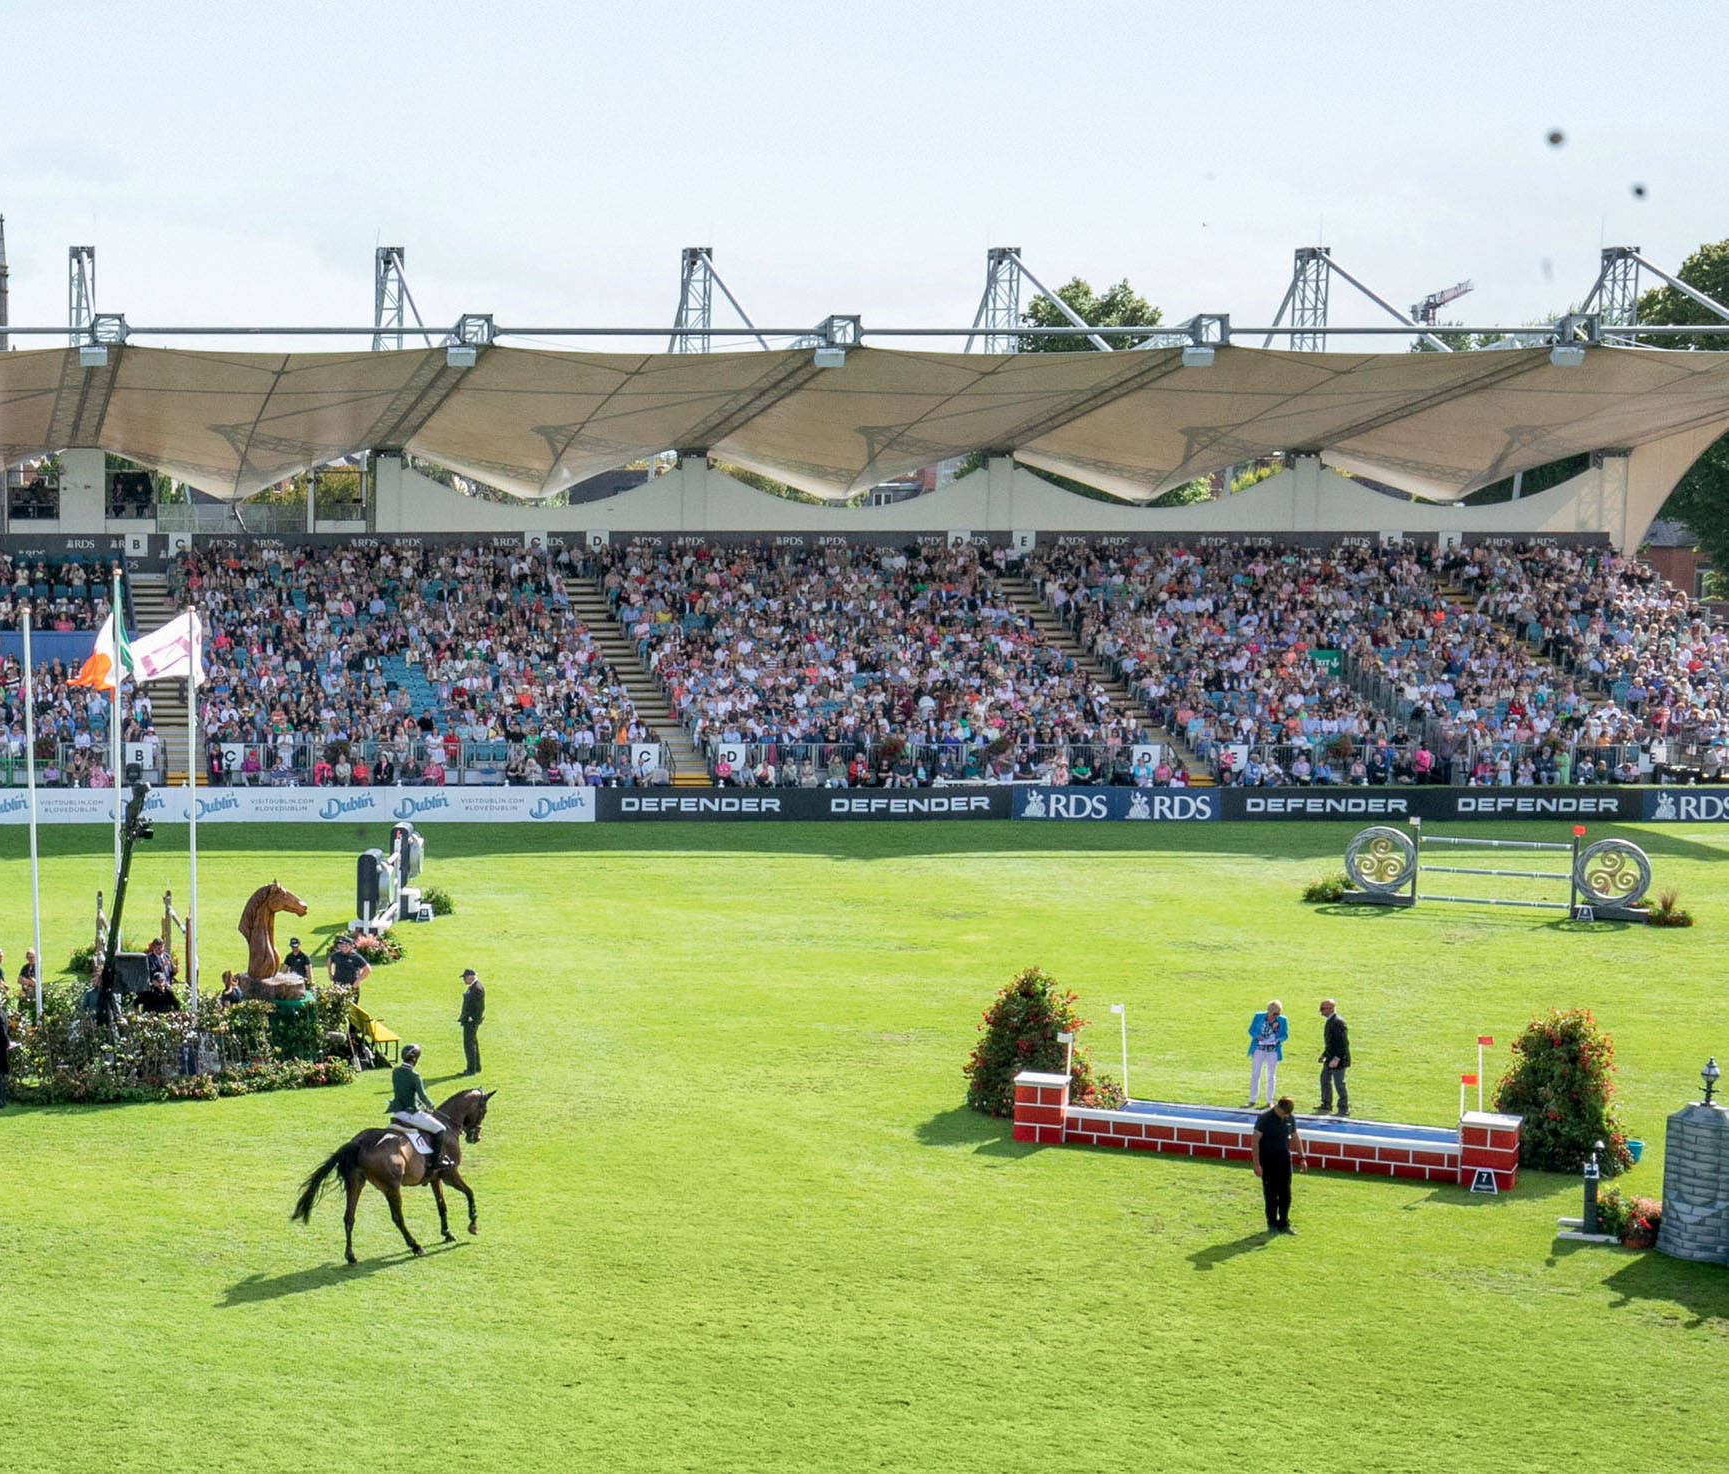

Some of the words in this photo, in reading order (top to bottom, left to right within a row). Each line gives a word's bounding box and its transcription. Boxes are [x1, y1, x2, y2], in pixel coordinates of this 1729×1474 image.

[75, 540, 95, 548] RDS
[133, 540, 140, 549] B
[358, 538, 378, 546] RDS
[500, 537, 520, 546] RDS
[593, 536, 602, 546] D
[783, 537, 803, 545] RDS
[827, 537, 846, 545] RDS
[1021, 536, 1027, 546] E
[1350, 537, 1371, 545] RDS
[1388, 536, 1394, 546] E
[135, 750, 143, 761] B
[225, 750, 236, 762] C
[640, 750, 651, 762] C
[727, 751, 737, 762] D
[1142, 753, 1151, 764] D
[1650, 753, 1656, 764] E
[184, 791, 239, 820] Dublin
[319, 792, 375, 819] Dublin
[393, 792, 449, 819] Dublin
[529, 791, 585, 819] Dublin
[621, 798, 781, 811] DEFENDER
[831, 796, 990, 812] DEFENDER
[1049, 794, 1107, 818] RDS
[1154, 795, 1212, 819] RDS
[1246, 798, 1408, 812] DEFENDER
[1457, 798, 1618, 812] DEFENDER
[1482, 1173, 1488, 1182] 7
